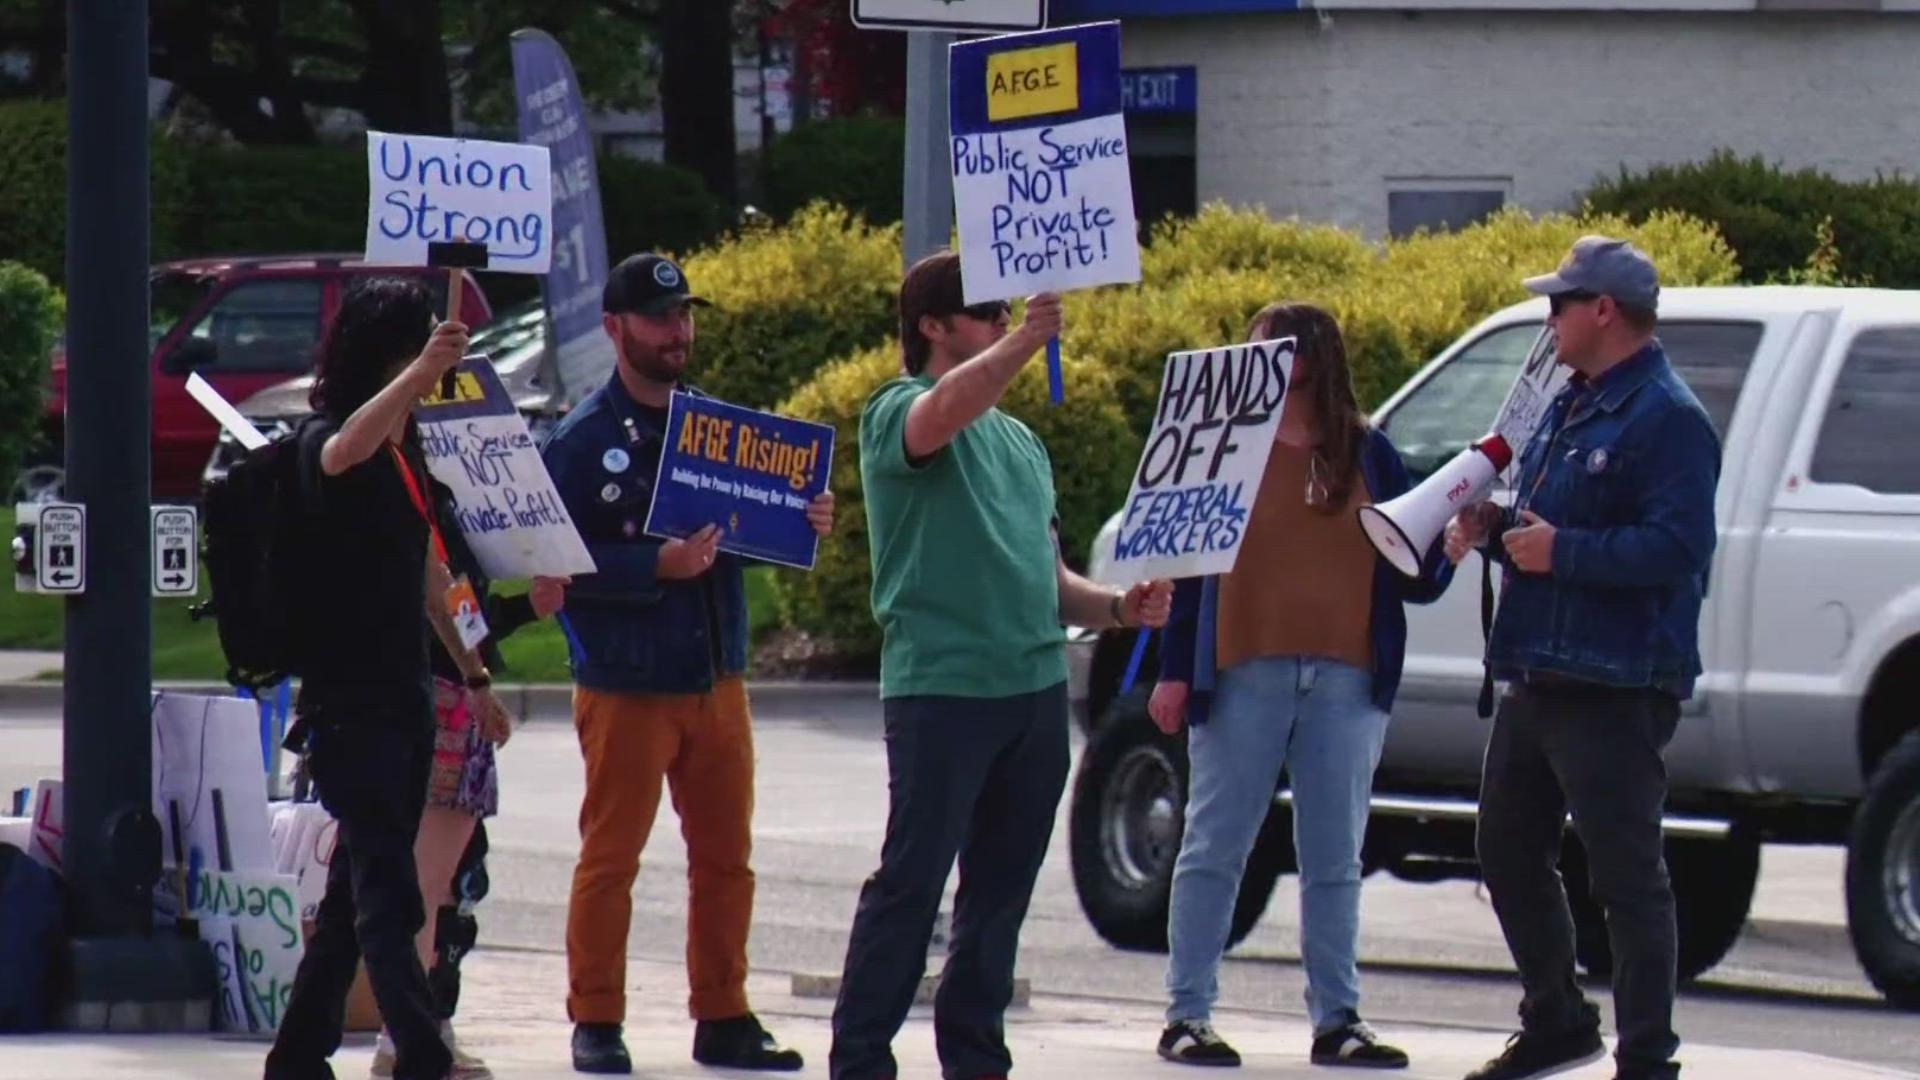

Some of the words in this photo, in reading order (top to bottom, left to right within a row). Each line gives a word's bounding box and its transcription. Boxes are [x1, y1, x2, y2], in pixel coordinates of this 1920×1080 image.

[1139, 73, 1179, 107] EXIT
[381, 139, 533, 191] Union
[953, 134, 1028, 176] Public
[1038, 128, 1125, 167] Service
[1007, 162, 1078, 204] NOT
[379, 190, 543, 259] Strong
[992, 196, 1115, 241] Private
[991, 229, 1108, 278] Profit!
[1158, 340, 1295, 427] HANDS
[467, 422, 533, 453] Service
[677, 411, 734, 464] AFGE
[735, 424, 820, 490] Rising!
[1138, 414, 1271, 490] OFF
[460, 450, 514, 487] NOT
[503, 487, 566, 528] Profit!
[733, 481, 742, 499] by
[1125, 480, 1247, 527] FEDERAL
[44, 524, 80, 533] BUTTON
[50, 513, 74, 521] PUSH
[157, 527, 191, 535] BUTTON
[163, 516, 186, 524] PUSH
[52, 534, 71, 542] FOR
[165, 537, 183, 545] FOR
[1114, 517, 1244, 561] WORKERS
